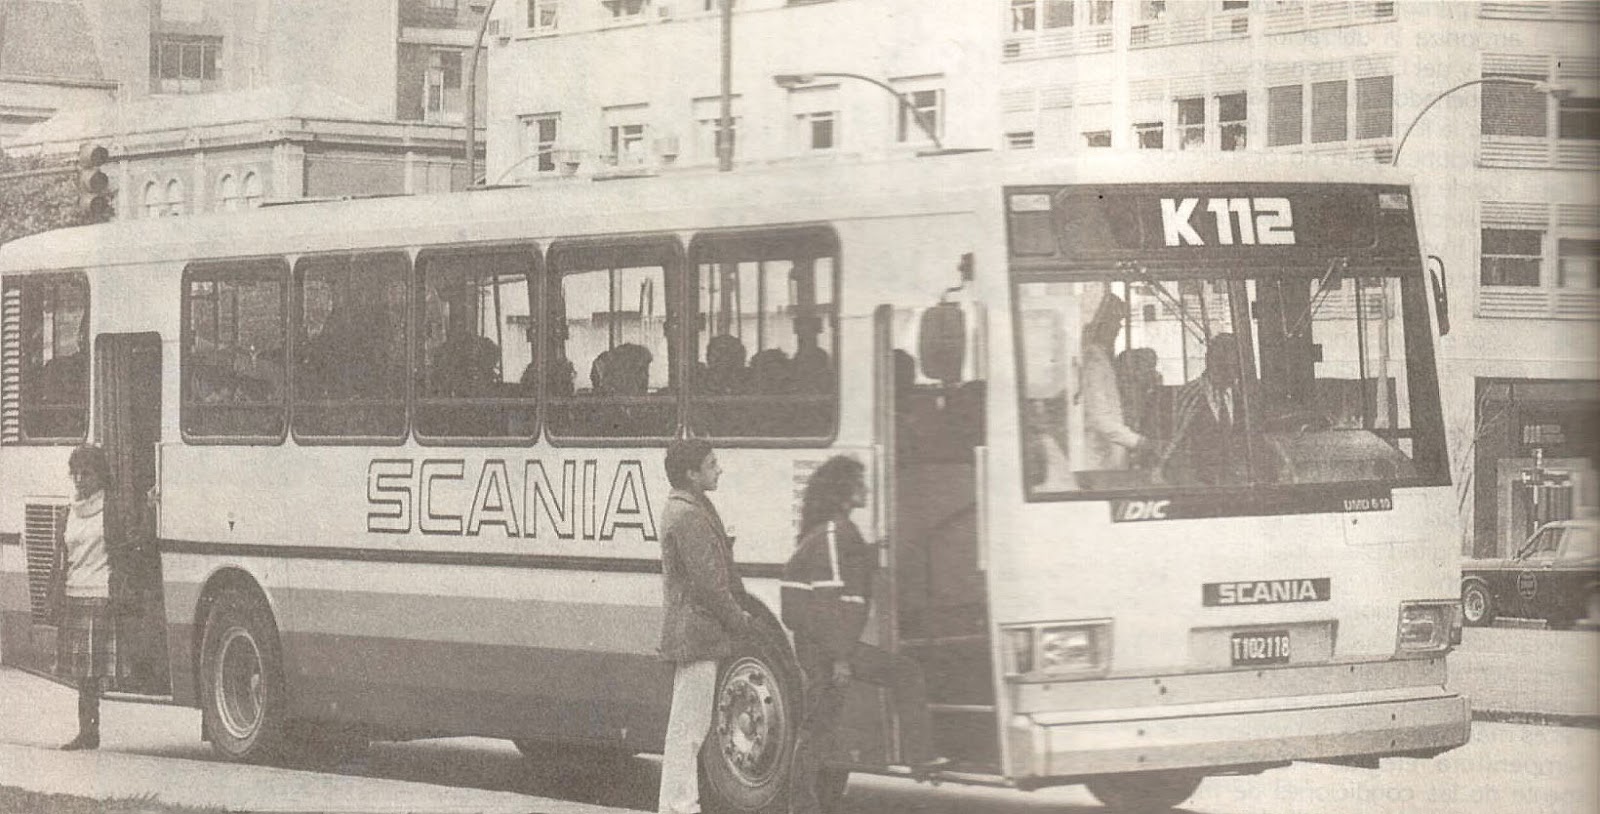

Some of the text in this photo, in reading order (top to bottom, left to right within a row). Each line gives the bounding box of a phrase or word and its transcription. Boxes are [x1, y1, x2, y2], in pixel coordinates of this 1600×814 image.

[1160, 197, 1296, 246] K 112
[367, 458, 659, 541] SCANIA
[1218, 580, 1318, 604] SCANIA
